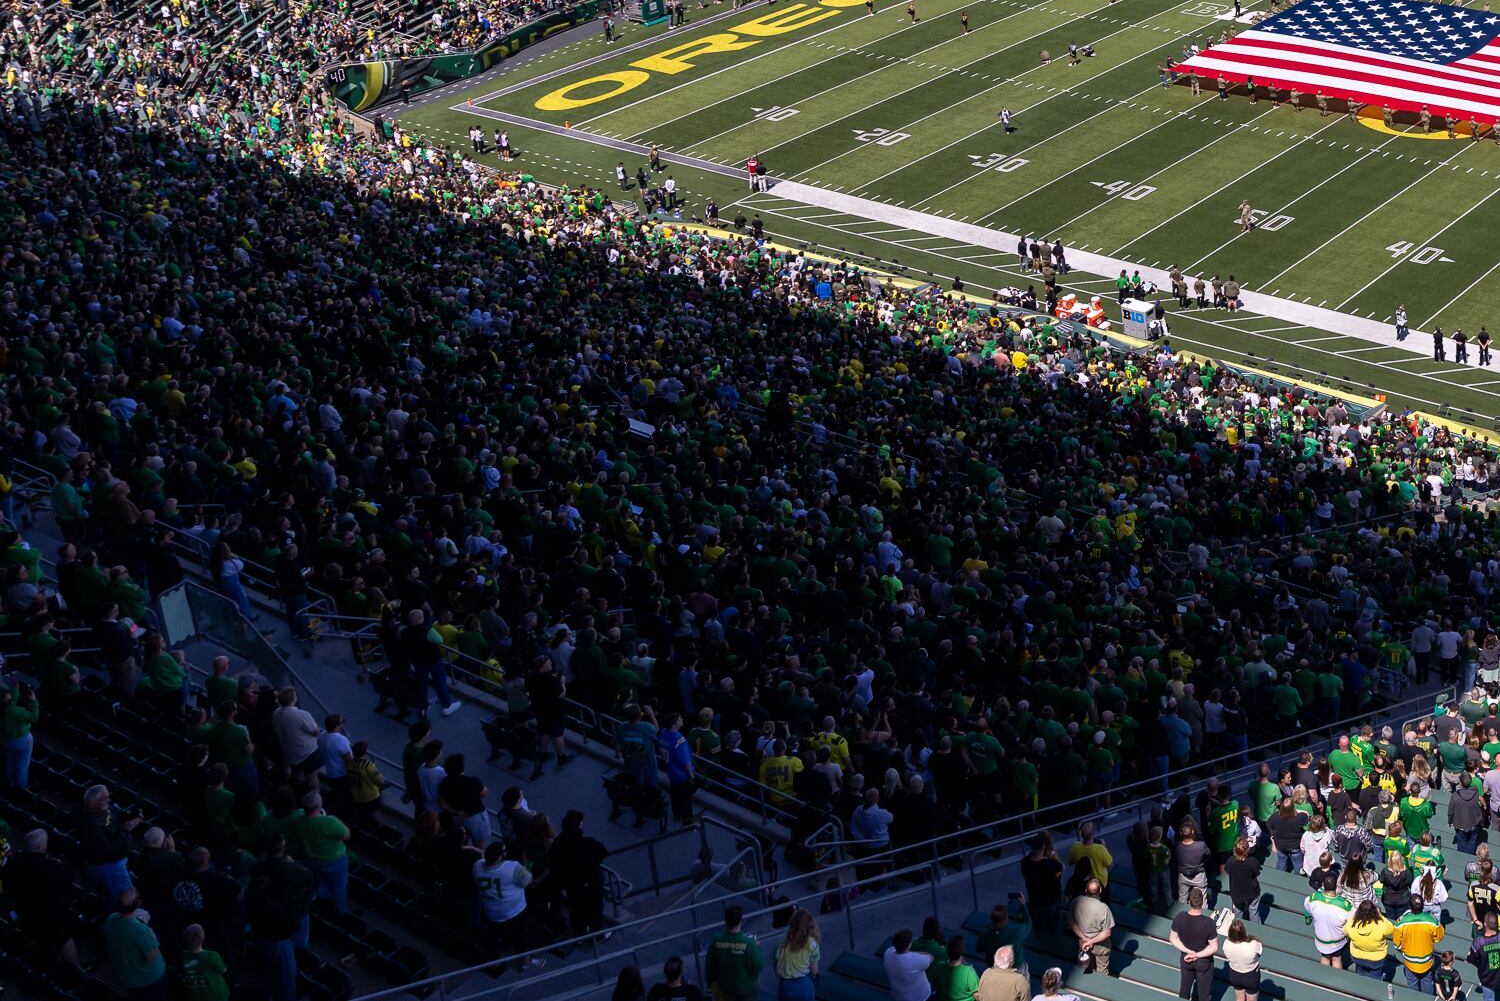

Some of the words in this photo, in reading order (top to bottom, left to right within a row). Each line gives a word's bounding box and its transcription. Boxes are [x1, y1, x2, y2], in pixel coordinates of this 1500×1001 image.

[330, 68, 345, 83] 40
[756, 106, 800, 122] 10
[855, 127, 911, 147] 20
[975, 153, 1029, 173] 30
[1102, 179, 1158, 201] 40
[1385, 241, 1444, 265] 40
[1221, 809, 1238, 830] 24
[478, 876, 503, 901] 21
[1474, 887, 1492, 906] 24
